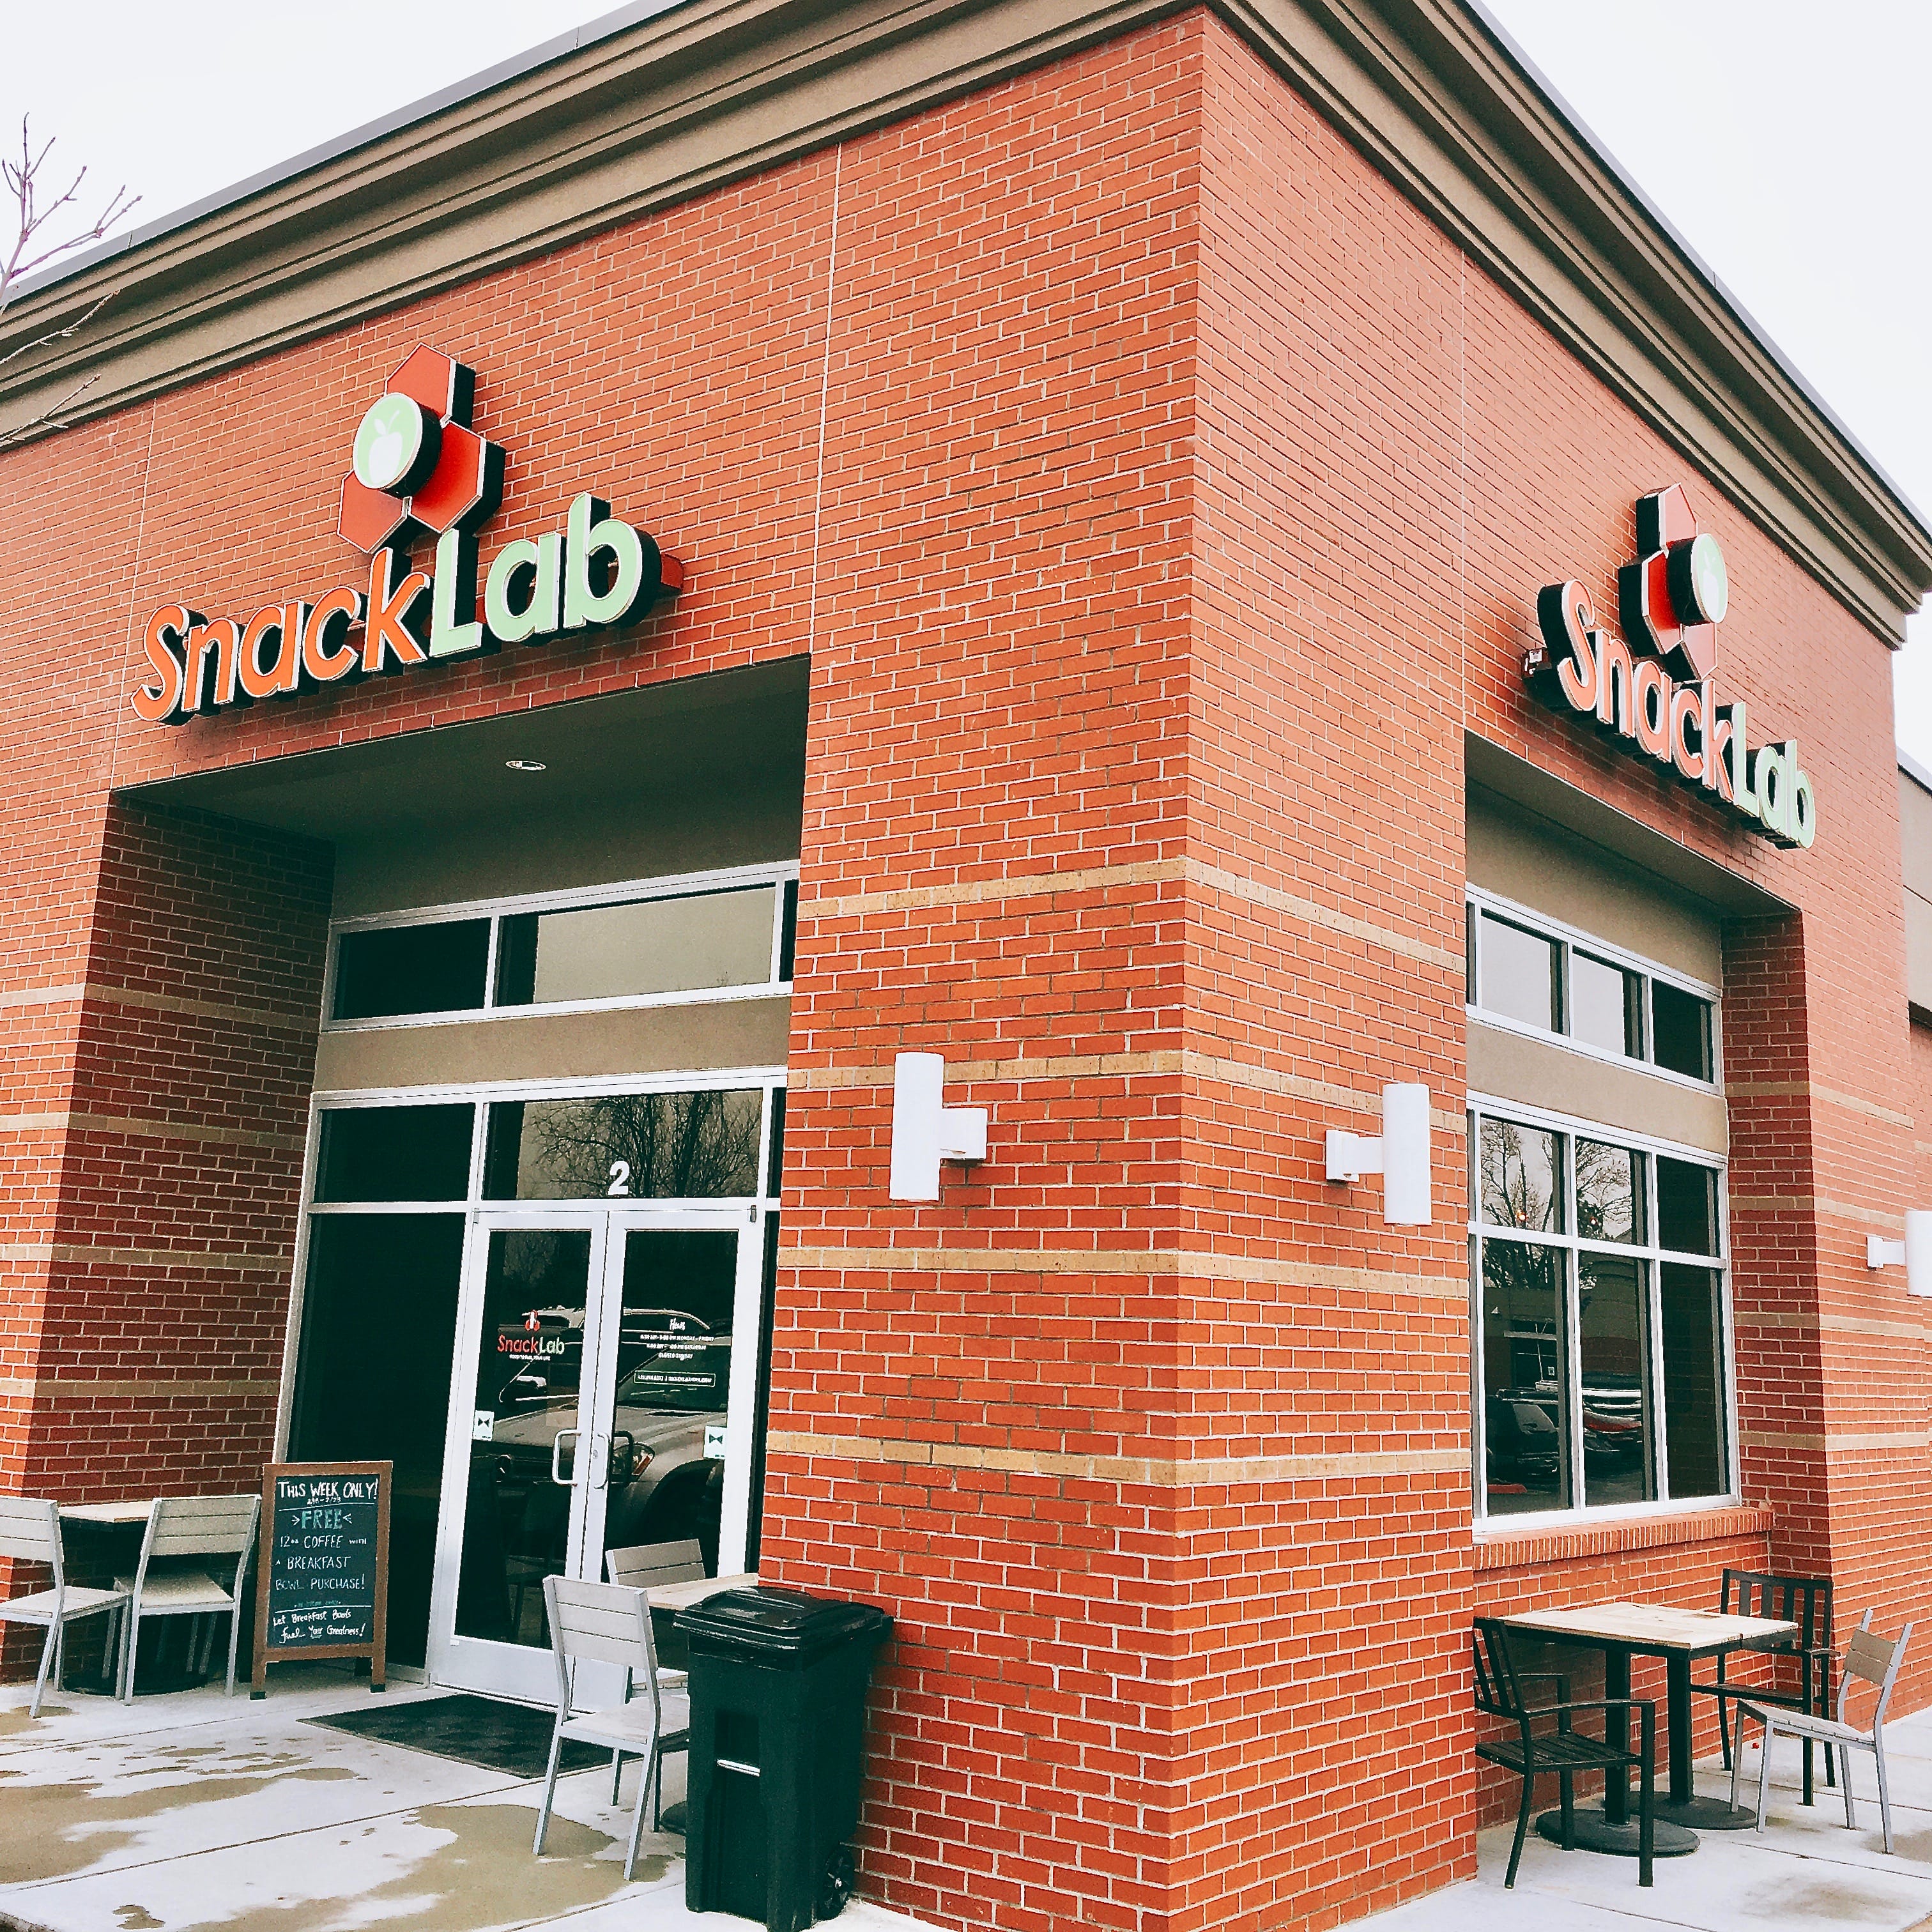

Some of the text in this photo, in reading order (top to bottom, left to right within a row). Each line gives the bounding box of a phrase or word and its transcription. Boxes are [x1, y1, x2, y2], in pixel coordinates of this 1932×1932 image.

[130, 492, 643, 725] SnackLab
[1554, 579, 1816, 849] SnackLab
[608, 1160, 630, 1195] 2
[497, 1334, 565, 1354] SnackLab
[310, 1481, 339, 1498] WEEK
[343, 1478, 378, 1499] ONLY!
[303, 1535, 344, 1549] COFFEE
[288, 1556, 351, 1570] BREAKFAST
[310, 1573, 365, 1590] PURCHASE!
